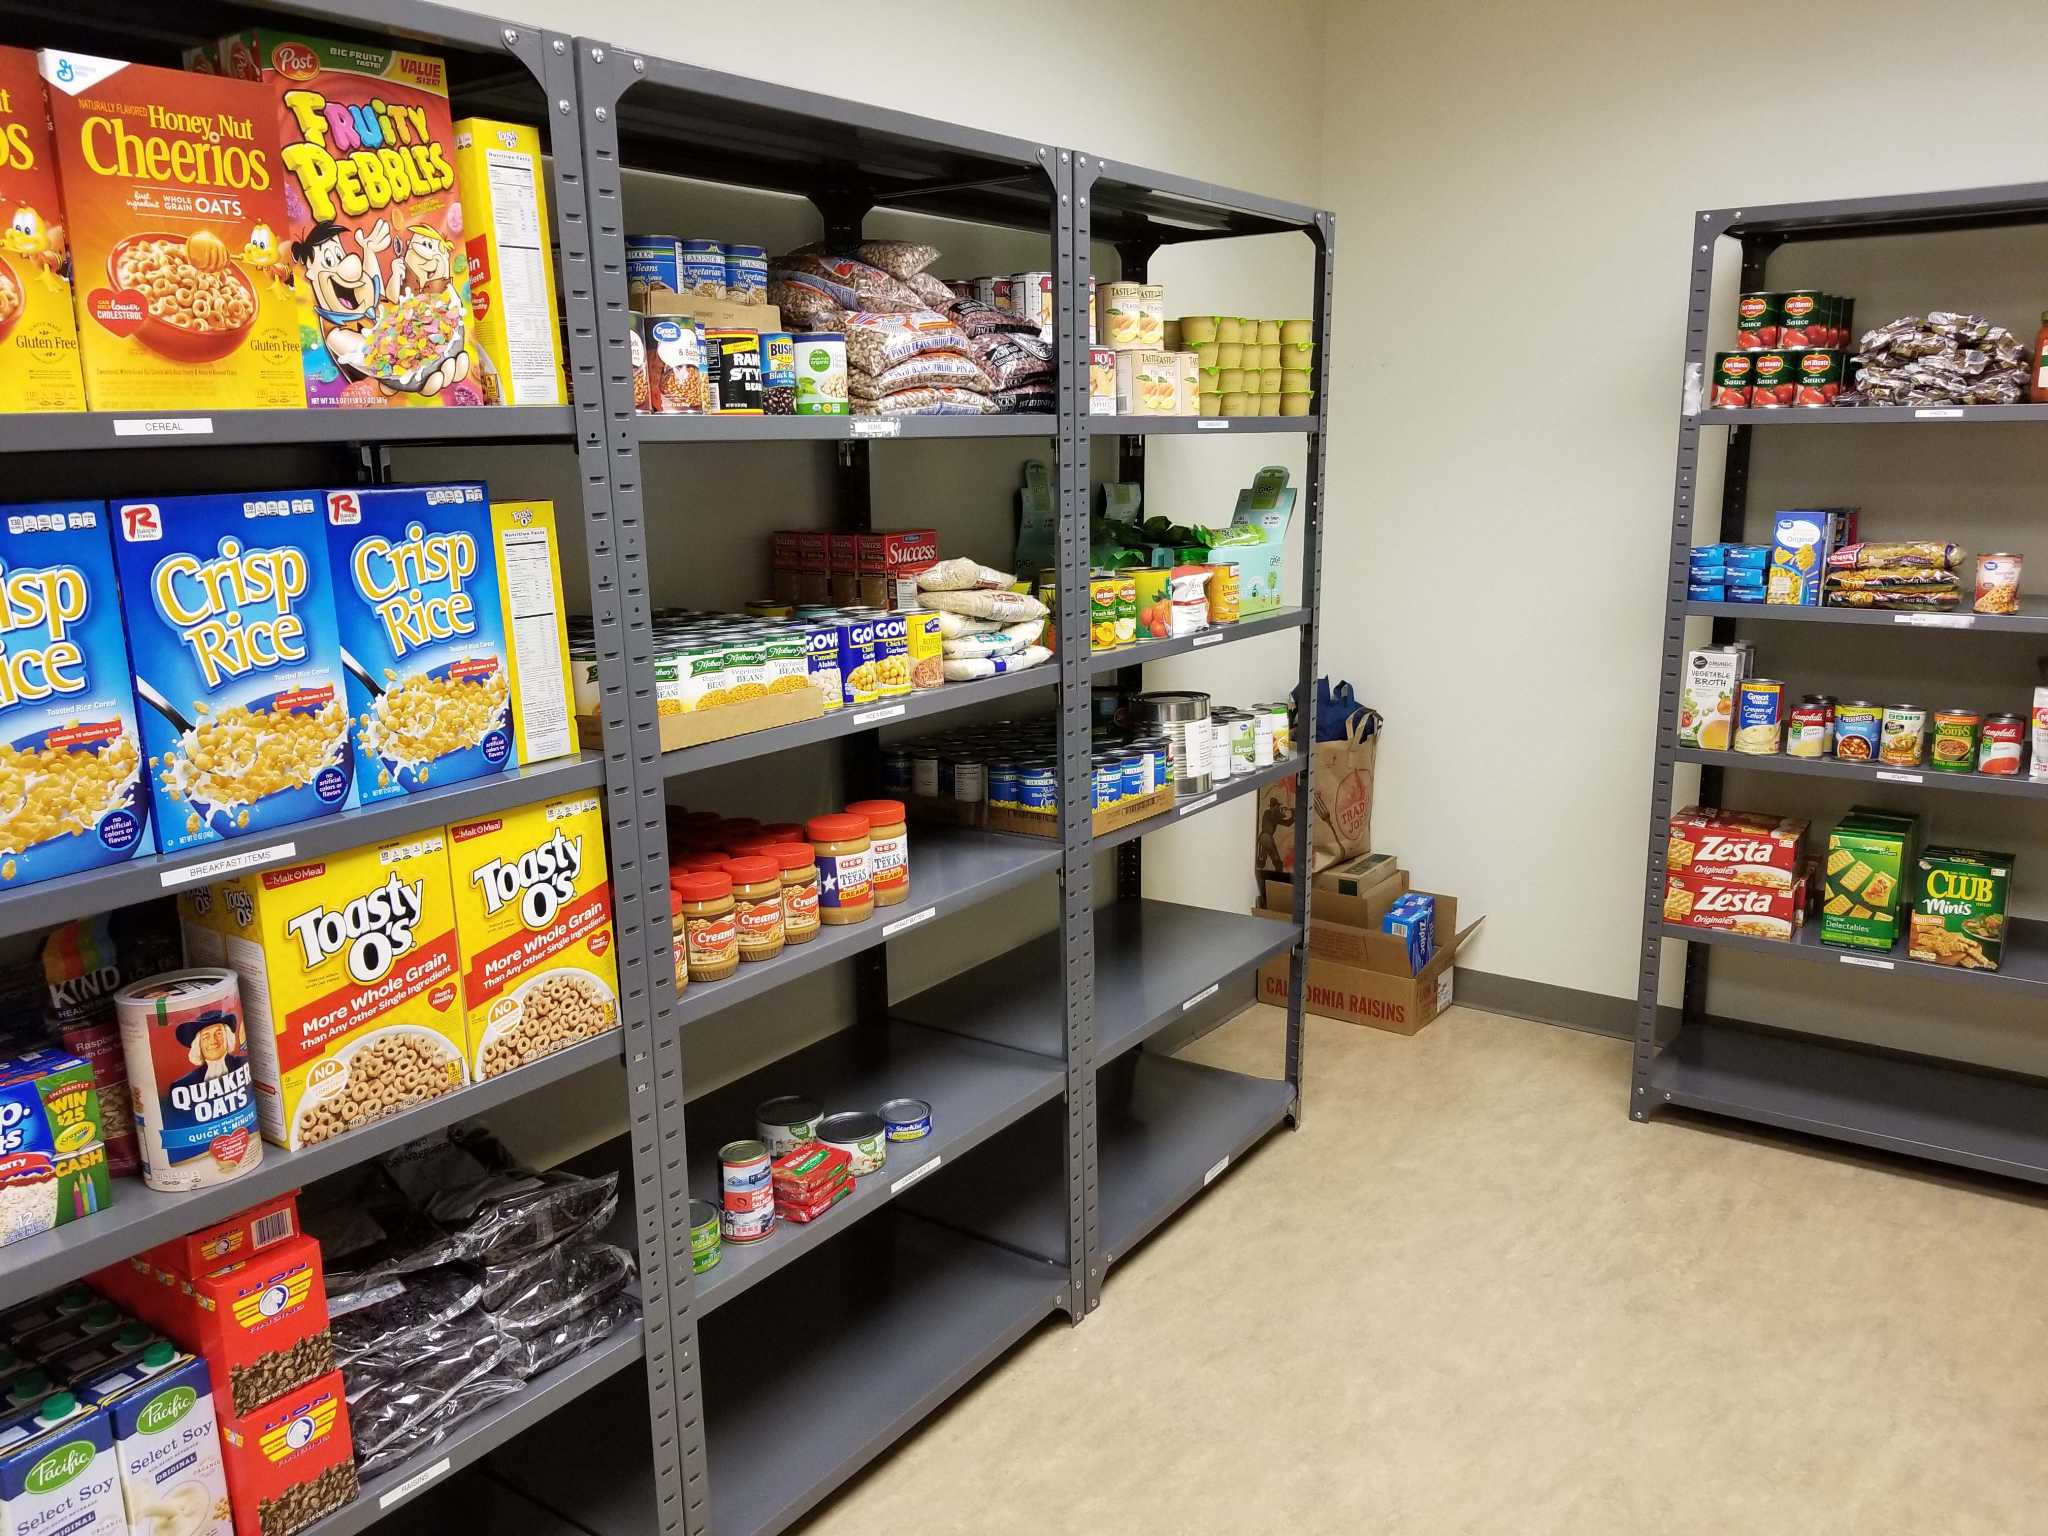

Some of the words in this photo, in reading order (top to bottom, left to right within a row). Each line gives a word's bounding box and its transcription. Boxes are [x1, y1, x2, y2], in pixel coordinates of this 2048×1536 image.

[280, 48, 313, 70] Post
[330, 48, 347, 57] BIG
[348, 50, 384, 62] FRUITY
[400, 58, 441, 79] VALUE
[148, 105, 213, 145] Honey
[218, 115, 254, 140] Nut
[81, 117, 270, 190] Cheerios
[281, 142, 455, 223] PEBBLES
[163, 194, 192, 204] WHOLE
[195, 197, 242, 216] OATS
[1740, 320, 1762, 328] Sauce
[1786, 318, 1809, 326] Sauce
[16, 336, 54, 349] Gluten
[55, 336, 77, 349] Free
[250, 339, 280, 351] Gluten
[282, 341, 300, 352] Free
[1724, 378, 1746, 386] Sauce
[145, 422, 183, 432] CEREAL
[354, 523, 475, 601] Crisp
[889, 543, 936, 564] Success
[156, 541, 307, 626] Crisp
[377, 588, 475, 656] Rice
[876, 621, 906, 639] GOY
[183, 611, 305, 687] Rice
[806, 632, 838, 652] GOY
[0, 640, 86, 704] ice
[1692, 670, 1731, 679] VEGETABLE
[1694, 678, 1727, 688] BROTH
[1748, 692, 1769, 701] Great
[1744, 706, 1765, 714] Cream
[1745, 712, 1768, 722] Celery
[1938, 724, 1971, 736] SOUPS
[104, 820, 132, 832] artificial
[104, 829, 125, 838] colors
[108, 834, 132, 844] flavors
[1694, 836, 1774, 863] Zesta
[190, 857, 241, 877] BREAKFAST
[243, 850, 272, 866] ITEMS
[472, 827, 583, 915] Toasty
[874, 856, 901, 869] TEXAS
[840, 870, 866, 886] TEXAS
[874, 871, 903, 882] CREAMY
[1926, 869, 1994, 903] CLUB
[522, 870, 574, 928] O's
[840, 888, 868, 900] CREAMY
[1693, 885, 1773, 913] Zesta
[741, 910, 780, 926] Creamy
[1922, 898, 1972, 916] Minis
[287, 871, 424, 968] Toasty
[1826, 921, 1870, 933] Delectables
[484, 949, 522, 976] More
[523, 924, 566, 954] Whole
[568, 902, 602, 929] Grain
[698, 927, 734, 944] Creamy
[1418, 921, 1426, 954] Ziploc
[348, 917, 414, 983] O's
[483, 974, 505, 990] Than
[506, 965, 522, 978] Any
[522, 950, 546, 968] Other
[546, 934, 570, 954] Single
[570, 914, 607, 939] Ingredient
[50, 966, 121, 1008] KIND
[302, 1006, 348, 1036] More
[351, 978, 402, 1009] Whole
[405, 951, 448, 985] Grain
[300, 1032, 327, 1050] Than
[329, 1022, 348, 1038] Any
[349, 1008, 377, 1026] Other
[379, 990, 407, 1010] Single
[408, 965, 452, 994] Ingredient
[494, 1000, 512, 1018] NO
[1349, 994, 1405, 1024] RAISINS
[314, 1063, 336, 1082] NO
[171, 1062, 252, 1110] QUAKER
[48, 1090, 88, 1116] WIN
[194, 1088, 248, 1122] OATS
[57, 1105, 86, 1127] $25
[188, 1130, 220, 1144] QUICK
[56, 1150, 104, 1178] CASH
[144, 1394, 190, 1425] Pacific
[131, 1440, 178, 1476] Select
[183, 1420, 214, 1444] Soy
[32, 1446, 90, 1487] Pacific
[156, 1454, 198, 1483] ORIGINAL
[17, 1492, 74, 1536] Select
[79, 1476, 114, 1501] Soy
